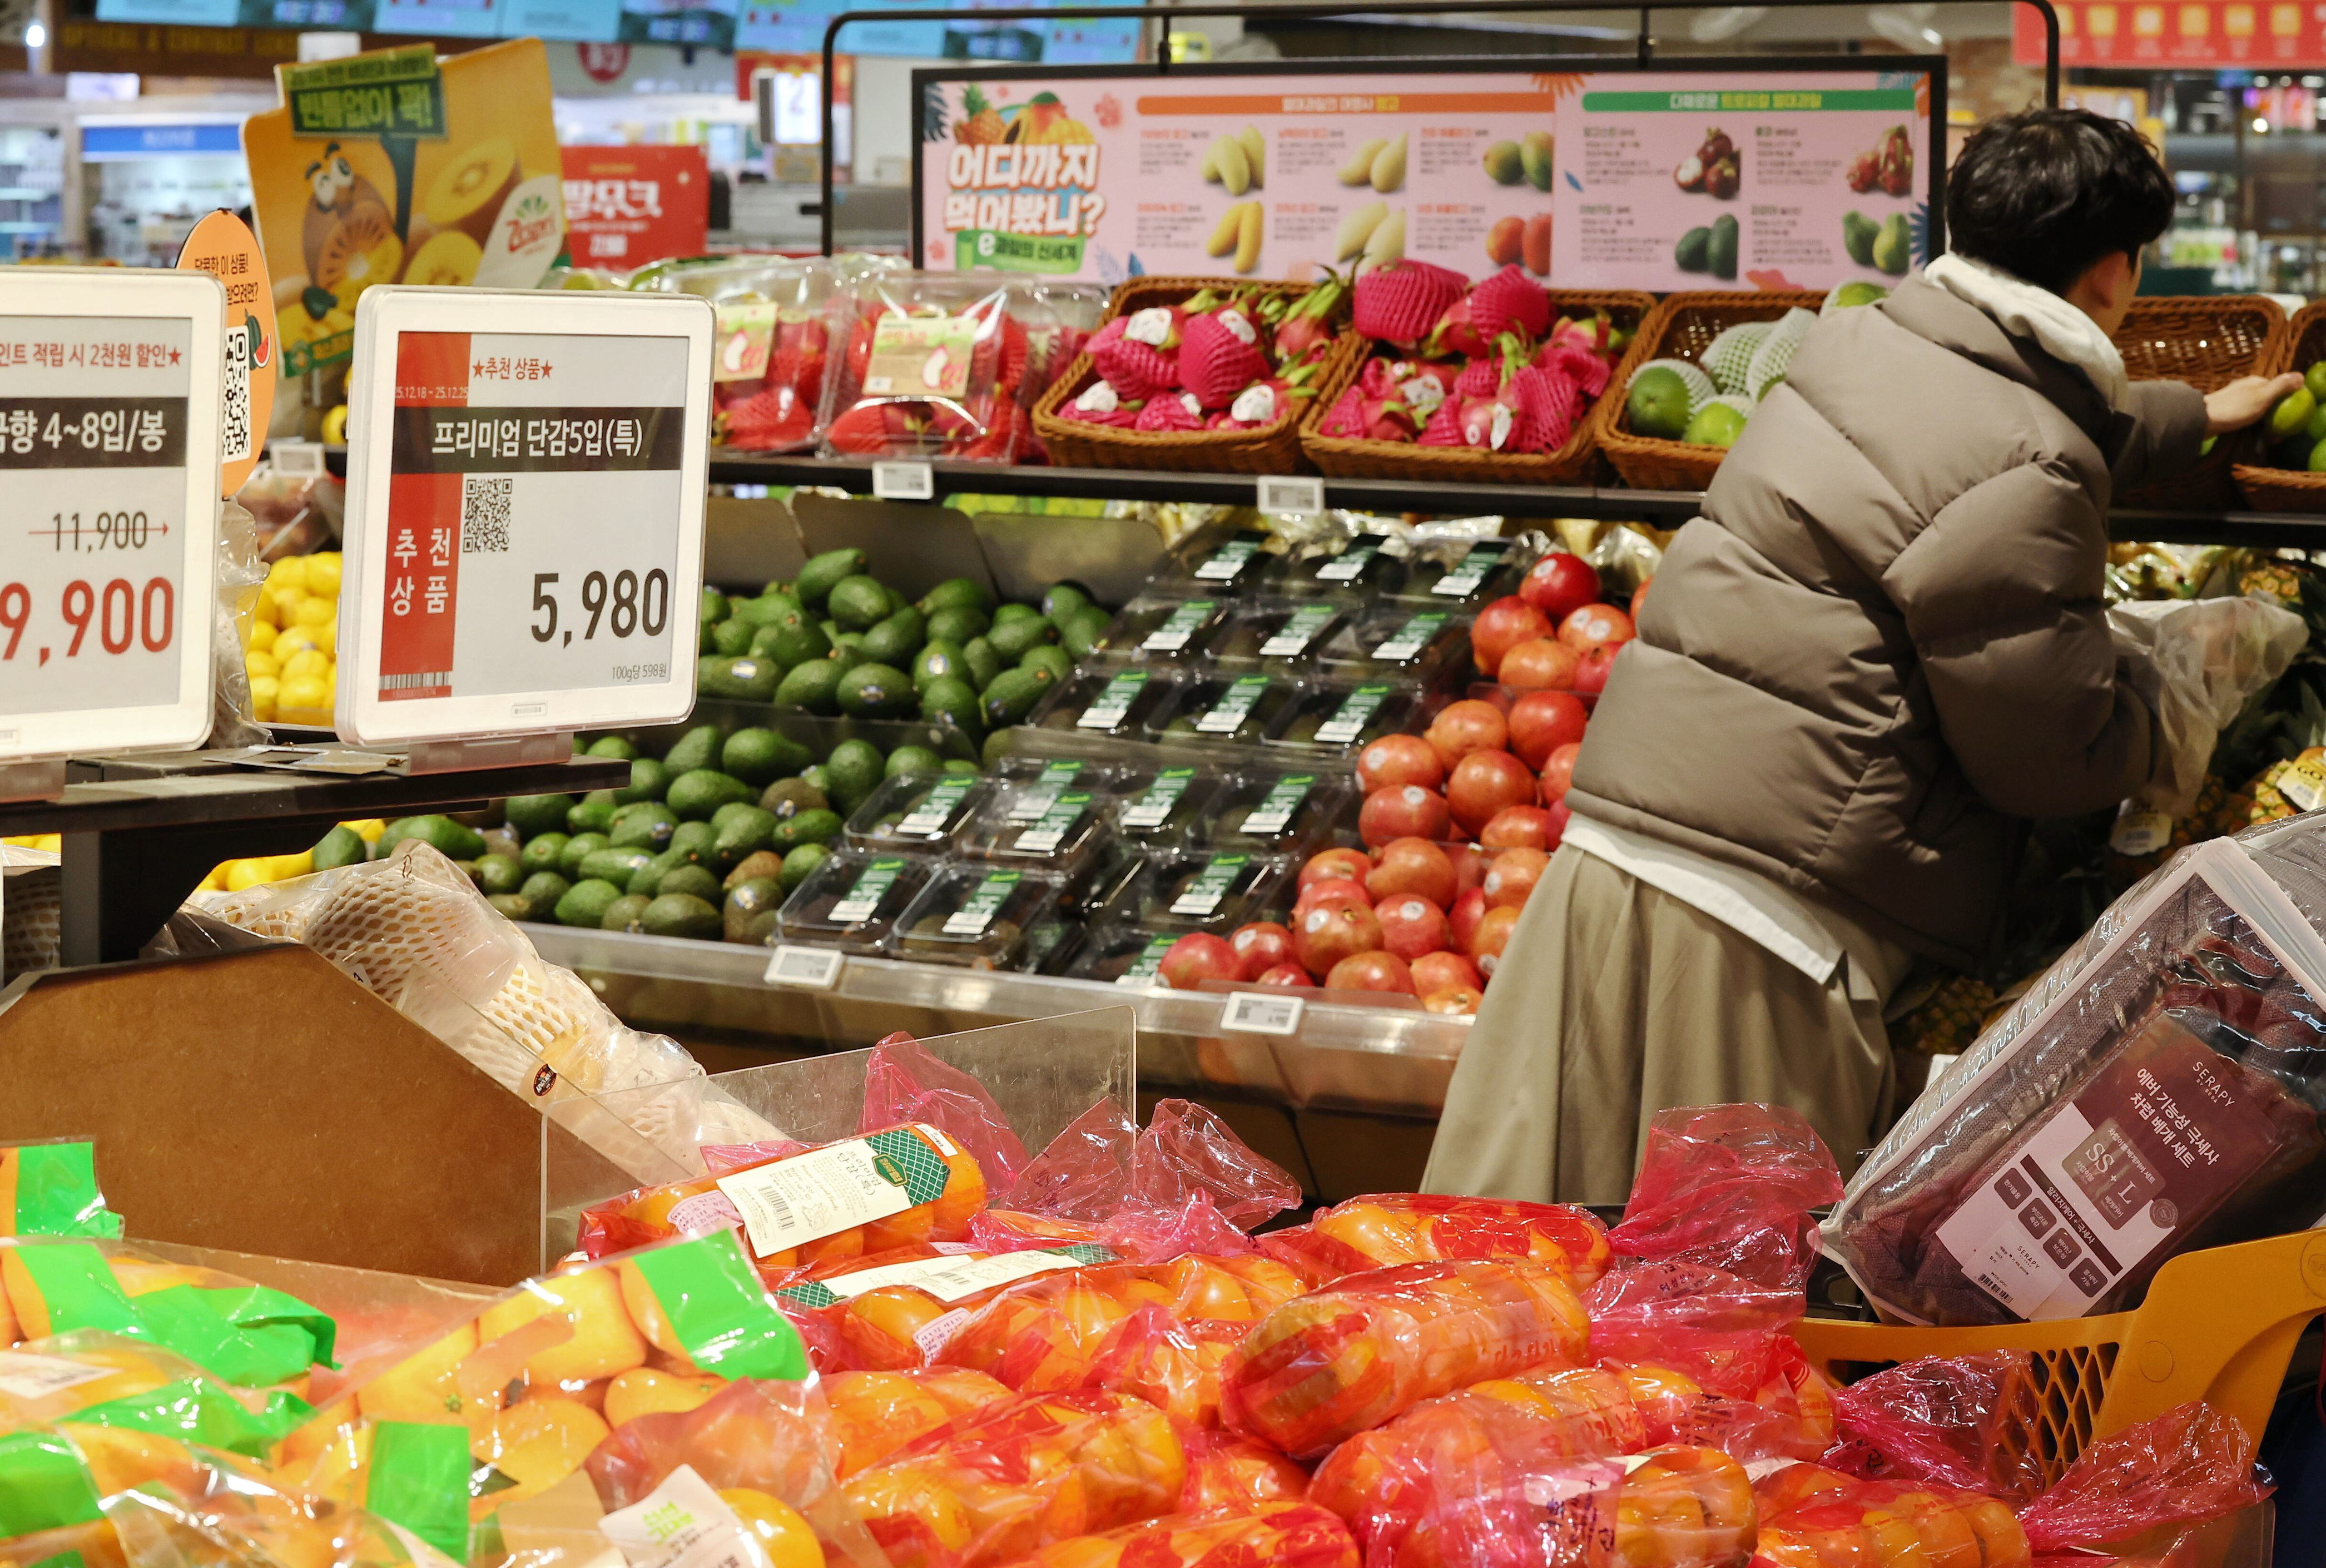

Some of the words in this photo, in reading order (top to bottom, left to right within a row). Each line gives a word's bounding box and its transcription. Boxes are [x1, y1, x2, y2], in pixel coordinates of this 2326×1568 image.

[949, 143, 1099, 190] 어디까지
[946, 192, 1105, 238] 먹어봤니?
[221, 255, 228, 275] 이
[231, 252, 248, 275] 상품!
[33, 343, 63, 366] 적립
[70, 344, 84, 367] 시
[91, 344, 132, 367] 2천원
[137, 344, 167, 367] 할인
[485, 357, 511, 379] 추천
[514, 358, 542, 380] 상품
[42, 409, 167, 454] 4~8입/봉
[432, 419, 520, 458] 프리미엄
[527, 418, 643, 456] 단감5입(특)
[53, 512, 147, 553] 11,900
[0, 577, 173, 667] 9,900
[531, 568, 669, 649] 5,980
[612, 663, 639, 681] 100g당
[642, 662, 667, 677] 598원
[2192, 1061, 2235, 1106] SERAPY
[2130, 1092, 2156, 1121] 차렵
[2151, 1116, 2177, 1145] 베개
[2171, 1142, 2195, 1168] 세트
[2137, 1067, 2163, 1098] 에버
[2156, 1092, 2191, 1130] 기능성
[2187, 1127, 2220, 1165] 극세사
[847, 1151, 881, 1187] 프리미엄
[2085, 1143, 2115, 1173] SS
[2117, 1180, 2136, 1204] L
[2145, 1171, 2157, 1185] 세트
[2047, 1187, 2075, 1220] 알러지케어
[2077, 1223, 2095, 1244] 극세사
[2017, 1246, 2040, 1269] SERAPY
